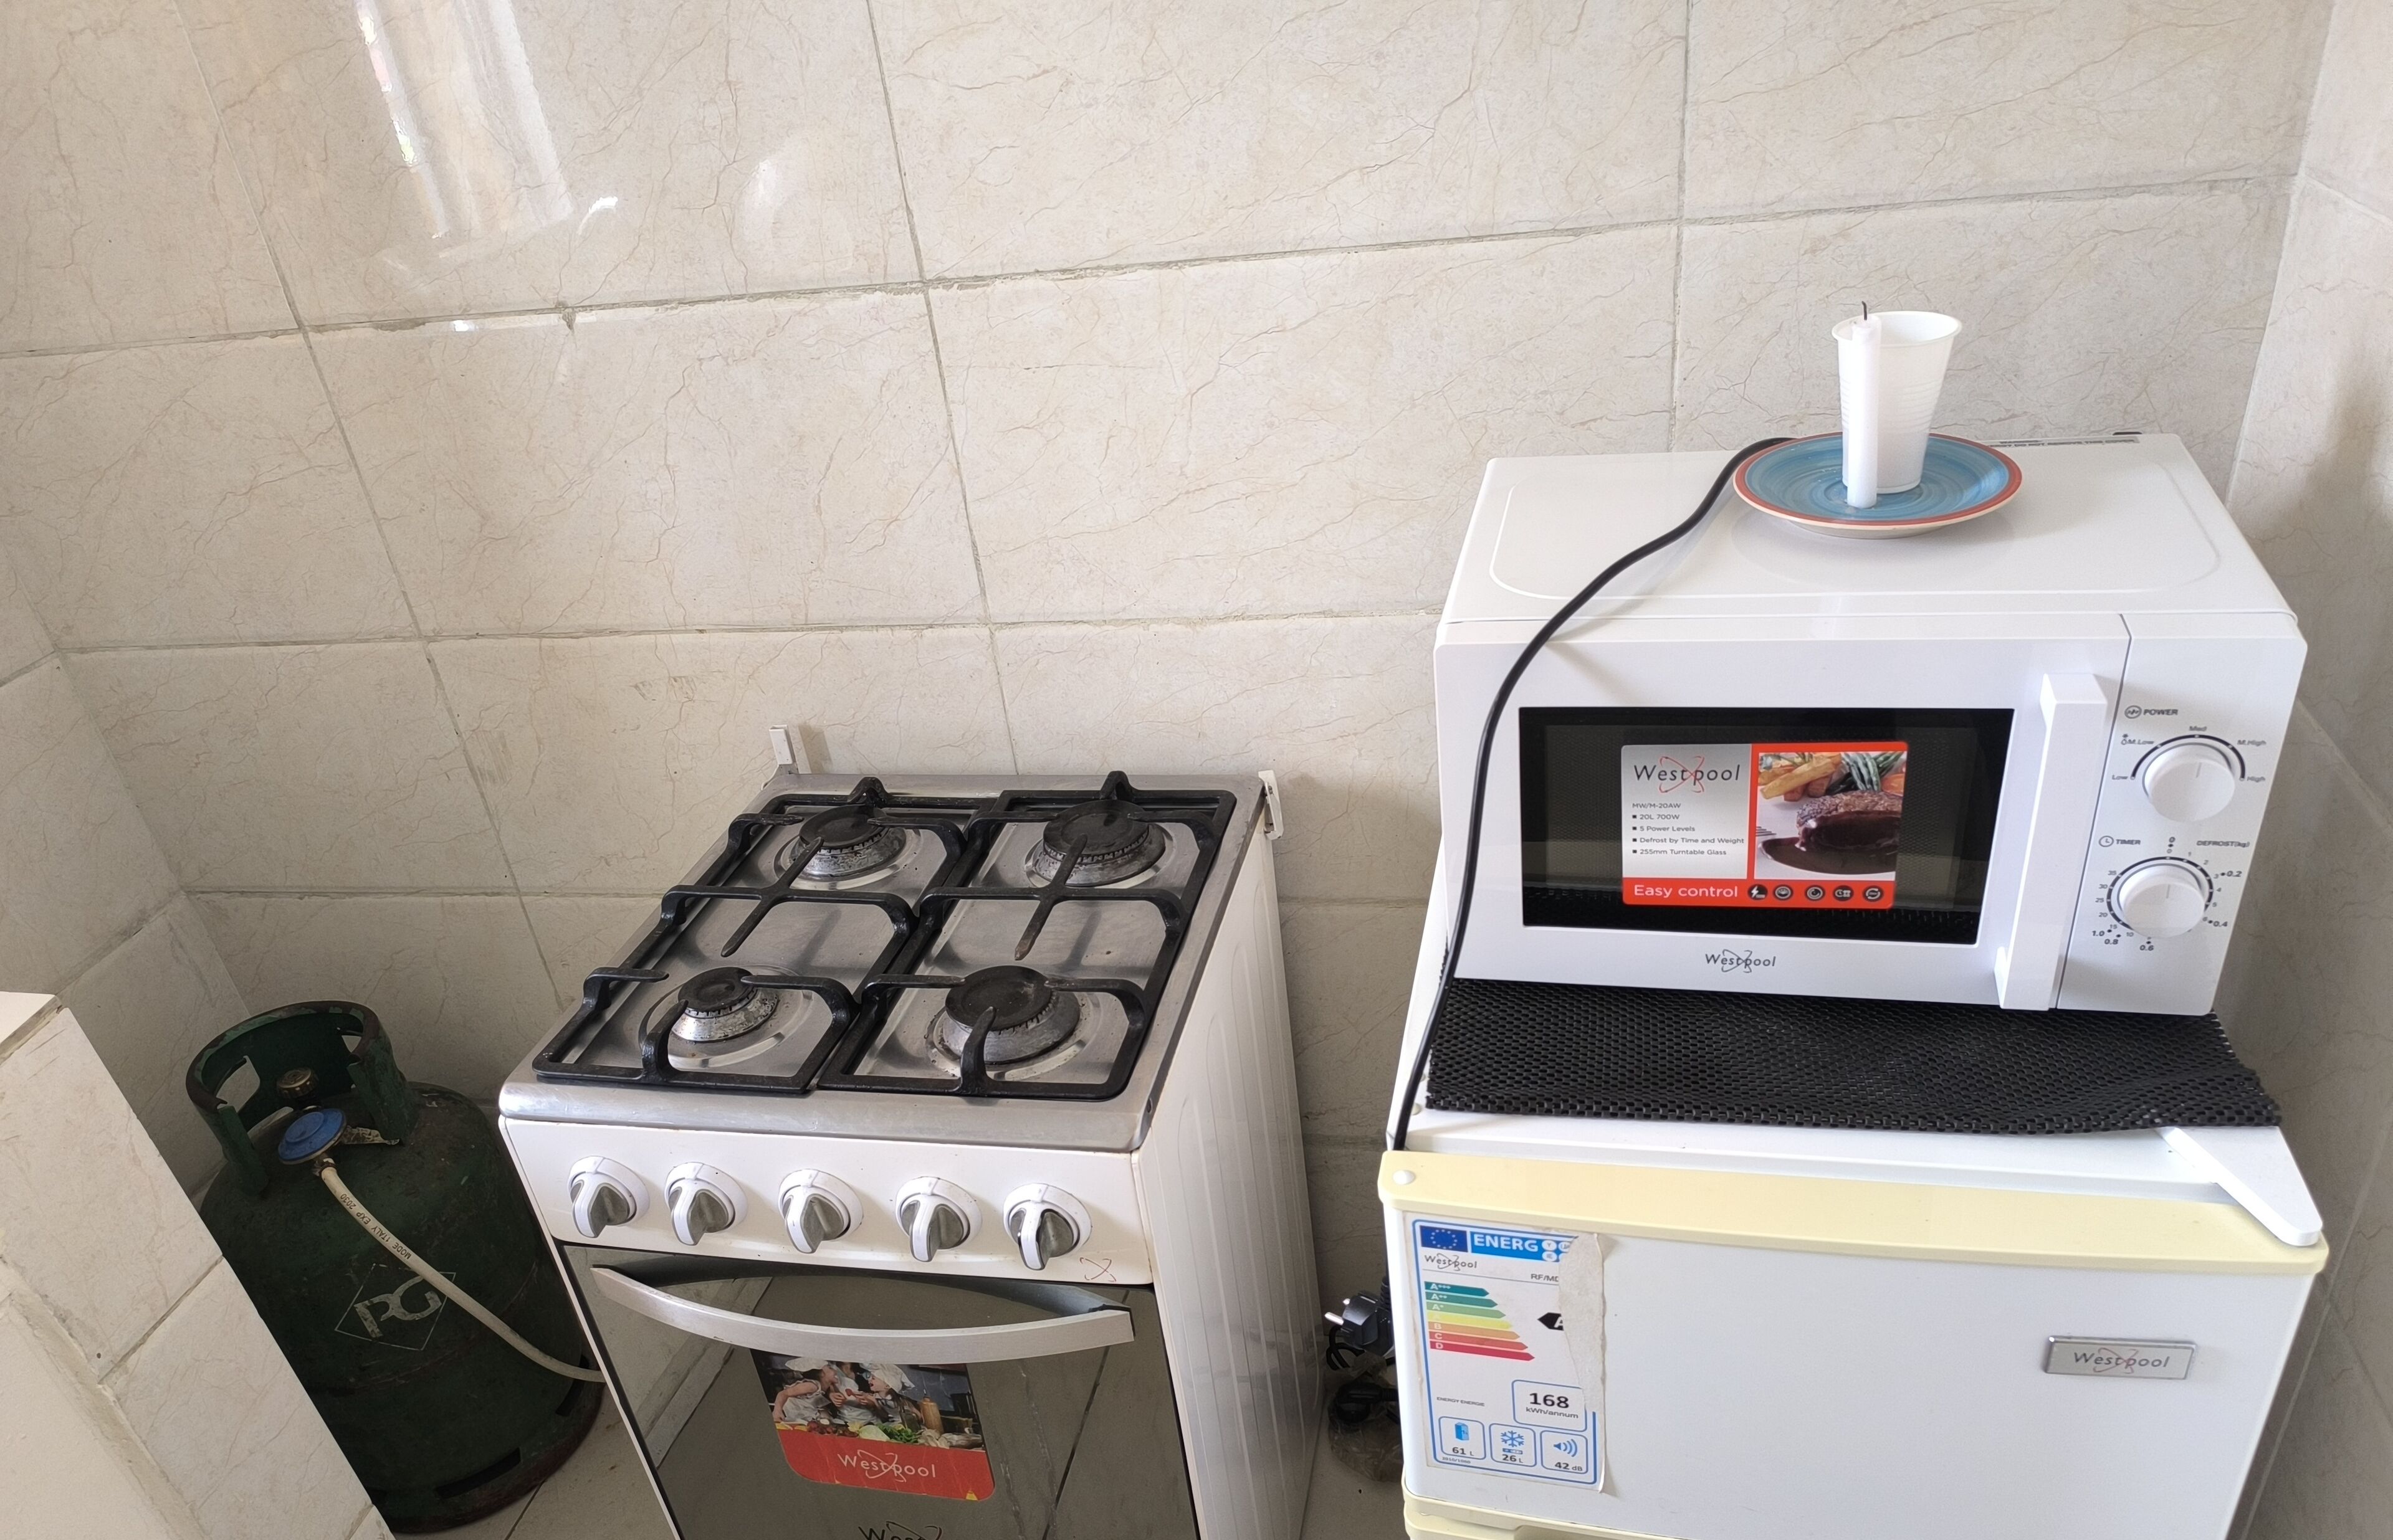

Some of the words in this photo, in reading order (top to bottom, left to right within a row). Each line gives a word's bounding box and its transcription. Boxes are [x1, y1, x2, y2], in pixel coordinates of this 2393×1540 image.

[1633, 764, 1741, 786] Westpool
[1634, 885, 1673, 898] Easy
[1678, 885, 1738, 898] control
[1705, 953, 1776, 969] Westpool
[340, 1194, 356, 1210] 2030
[356, 1212, 371, 1225] EXP
[1473, 1233, 1539, 1252] ENERG
[392, 1242, 412, 1260] MODE
[1424, 1254, 1478, 1270] Westpool
[2073, 1352, 2171, 1369] Westpool
[1529, 1392, 1570, 1409] 168
[1526, 1407, 1579, 1419] kWh/annum
[1452, 1447, 1466, 1455] 61
[1502, 1454, 1517, 1462] 26
[837, 1453, 936, 1478] Westpool
[1554, 1462, 1570, 1470] 42
